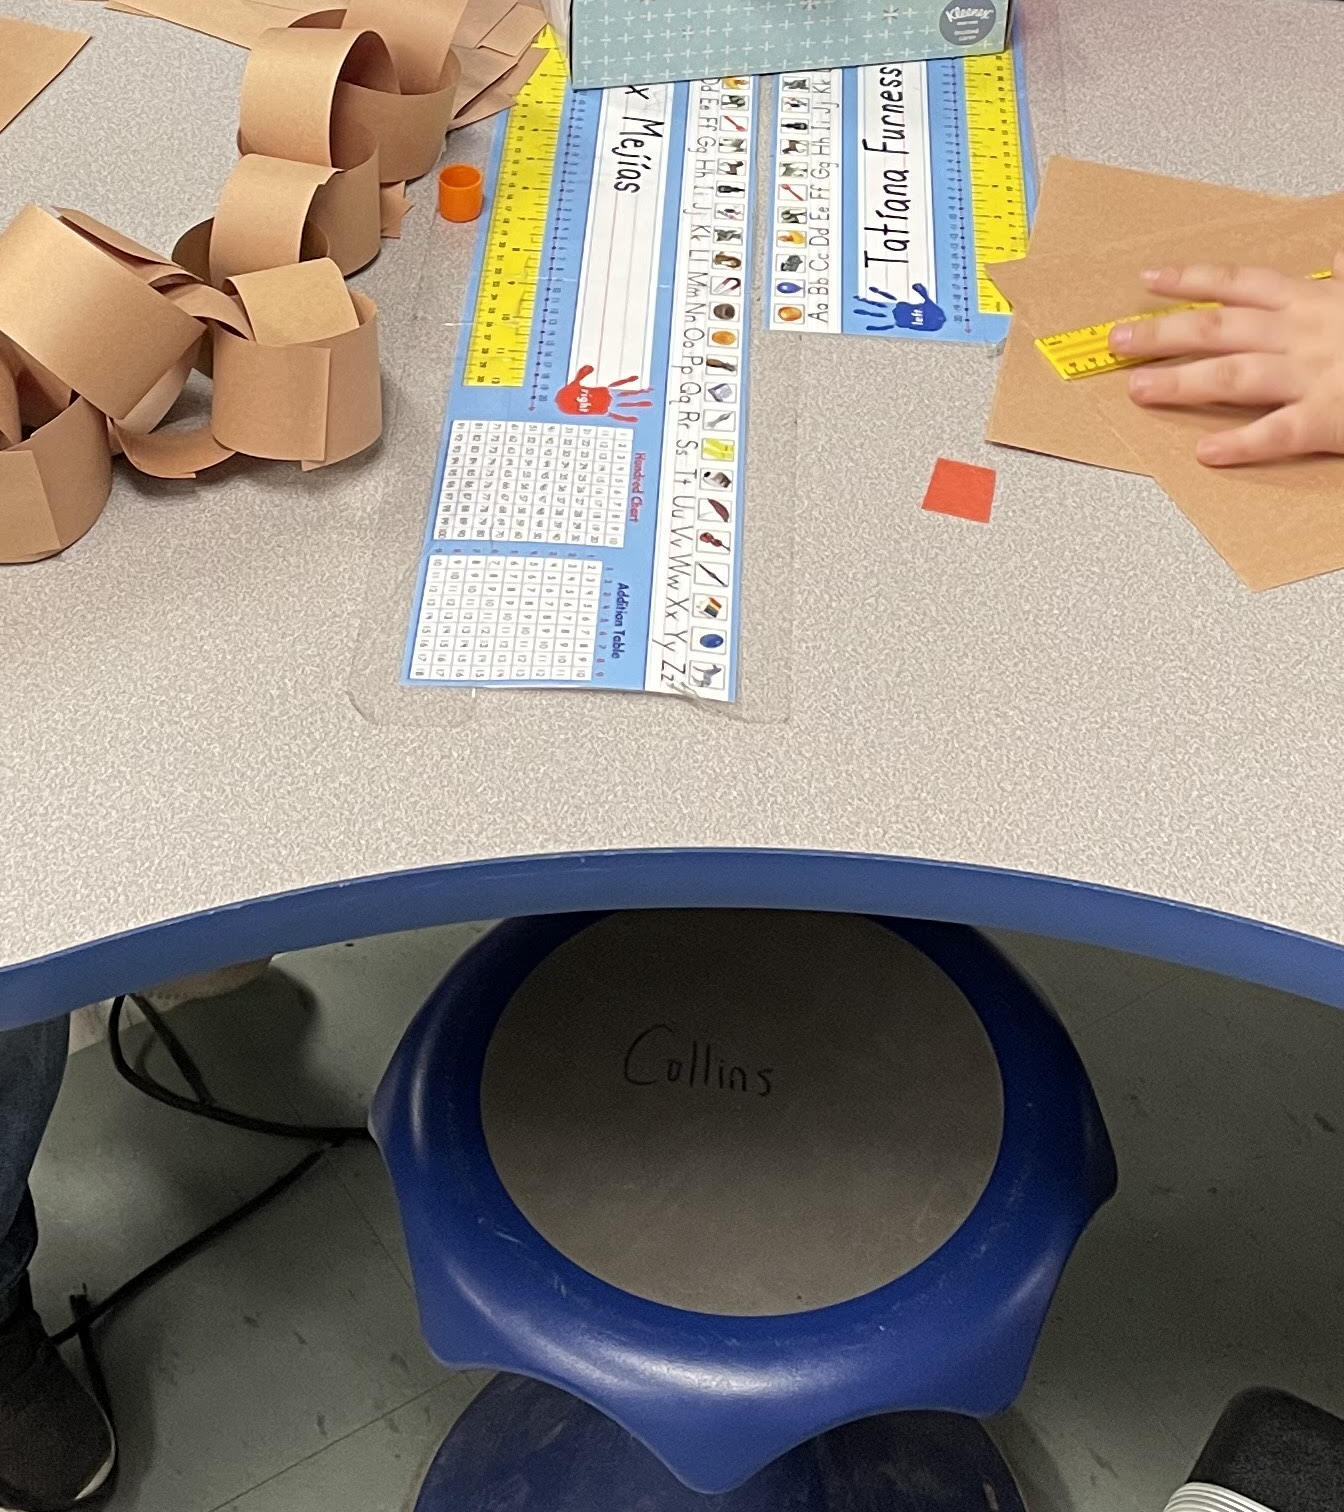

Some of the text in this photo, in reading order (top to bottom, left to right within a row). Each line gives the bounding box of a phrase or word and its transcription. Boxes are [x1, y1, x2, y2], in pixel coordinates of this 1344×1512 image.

[945, 6, 995, 23] Kleenex
[812, 77, 831, 94] Kk
[700, 97, 720, 112] Ee
[811, 100, 839, 114] Jj
[698, 117, 718, 133] Ff
[687, 135, 716, 154] Gg
[811, 137, 830, 156] Hh
[695, 159, 715, 178] Hh
[810, 161, 839, 180] Gg
[862, 65, 912, 268] Tatiana Furness
[809, 184, 830, 201] Ff
[683, 202, 712, 216] Jj
[809, 206, 830, 222] Ee
[690, 224, 711, 242] Kk
[808, 227, 830, 247] Dd
[808, 252, 830, 272] Cc
[686, 271, 709, 299] Mm
[807, 276, 829, 296] Bb
[684, 303, 706, 323] Nn
[807, 303, 829, 324] Aa
[912, 308, 924, 326] left
[682, 327, 705, 349] Oo
[671, 355, 703, 376] Pp
[576, 388, 592, 413] right
[668, 382, 701, 406] Qq
[678, 411, 700, 430] Rr
[676, 439, 698, 456] Ss
[629, 452, 646, 523] Hundred Chart
[674, 469, 698, 486] Tt
[672, 495, 695, 519] Uu
[670, 526, 693, 548] Vv
[667, 554, 692, 590] Ww
[665, 596, 689, 621] Xx
[611, 581, 630, 660] Addition Table
[652, 630, 687, 652] Yy
[660, 659, 686, 682] Zz
[623, 1022, 775, 1098] Collins
